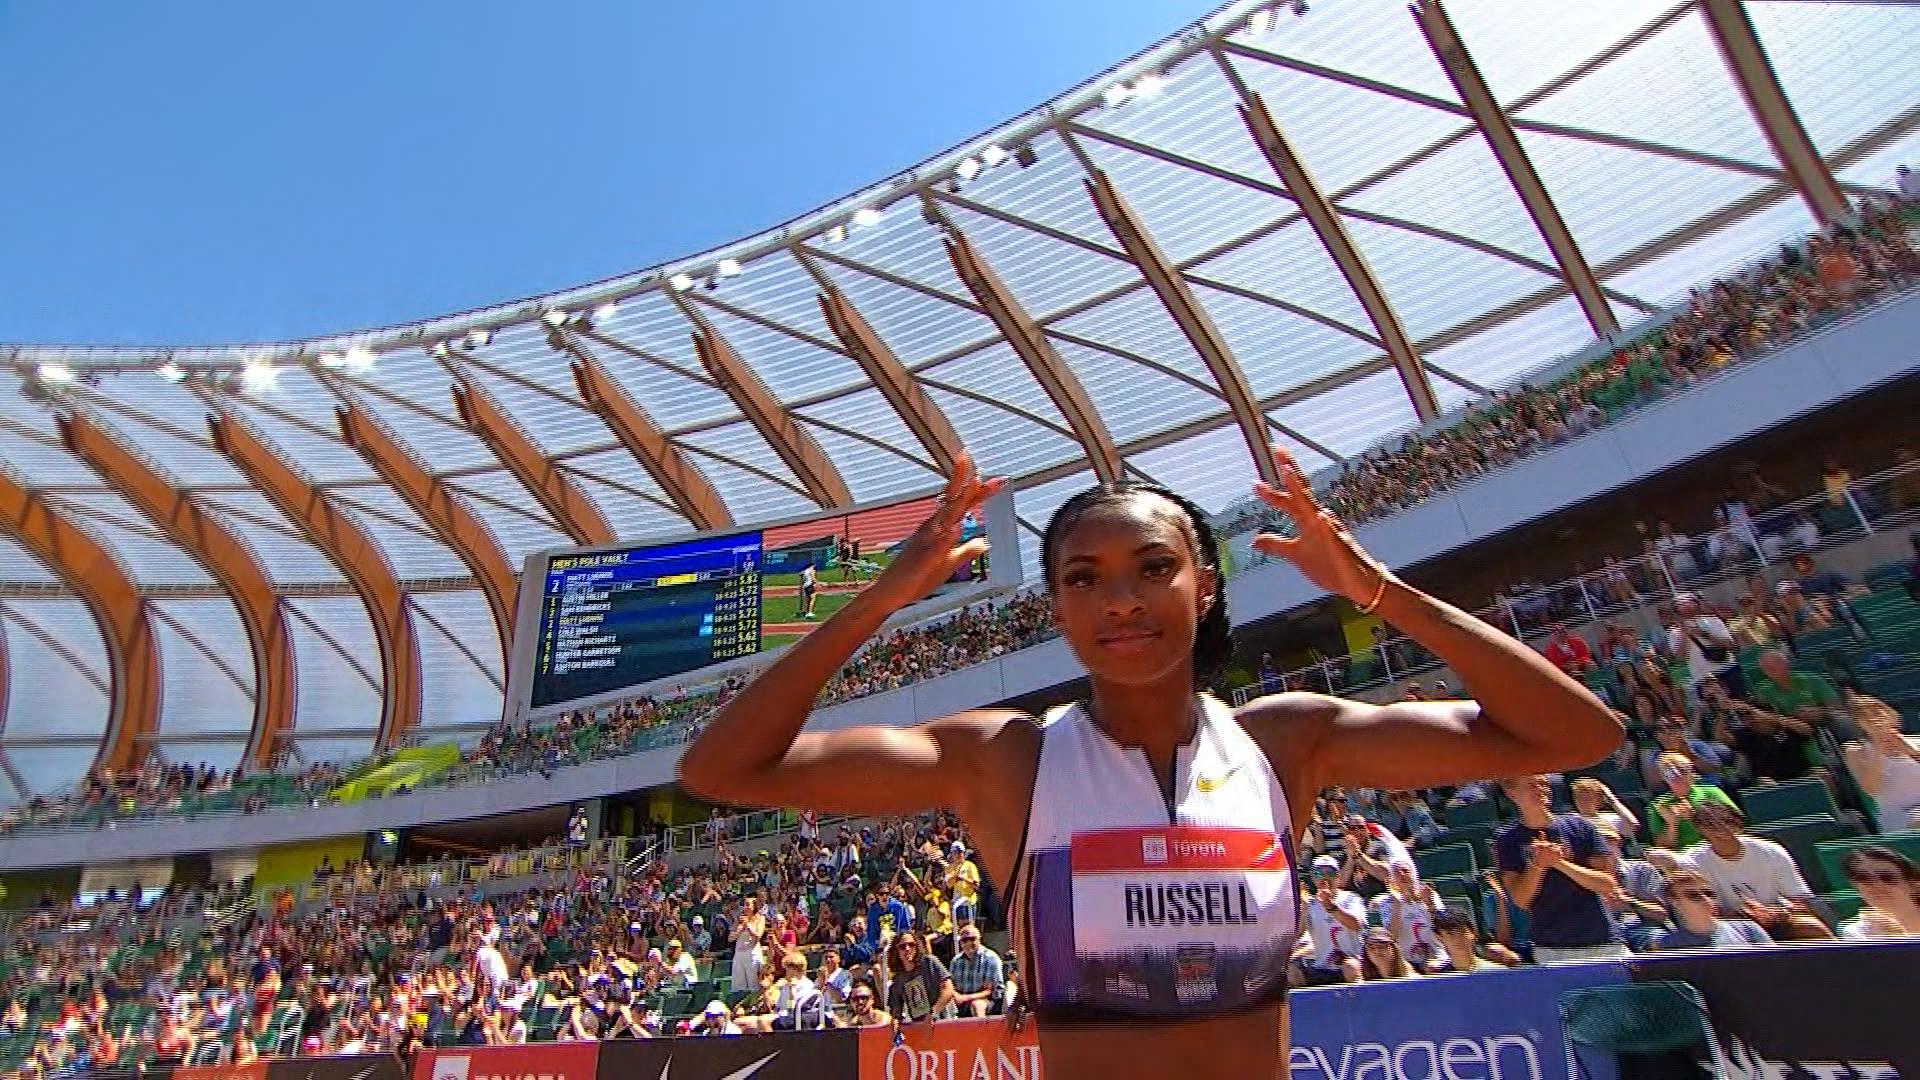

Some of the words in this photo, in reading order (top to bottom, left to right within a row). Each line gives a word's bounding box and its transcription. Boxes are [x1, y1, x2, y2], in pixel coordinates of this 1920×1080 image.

[552, 558, 578, 569] MEN'S
[579, 556, 600, 567] POLE
[601, 553, 629, 565] VAULT
[552, 580, 560, 593] 2
[739, 585, 757, 597] 5.72
[739, 608, 757, 620] 5.72
[739, 619, 757, 631] 5.72
[738, 630, 757, 642] 5.62
[738, 642, 757, 654] 5.62
[541, 664, 549, 675] 7
[1171, 840, 1226, 857] TOYOTA
[1125, 881, 1258, 929] RUSSELL
